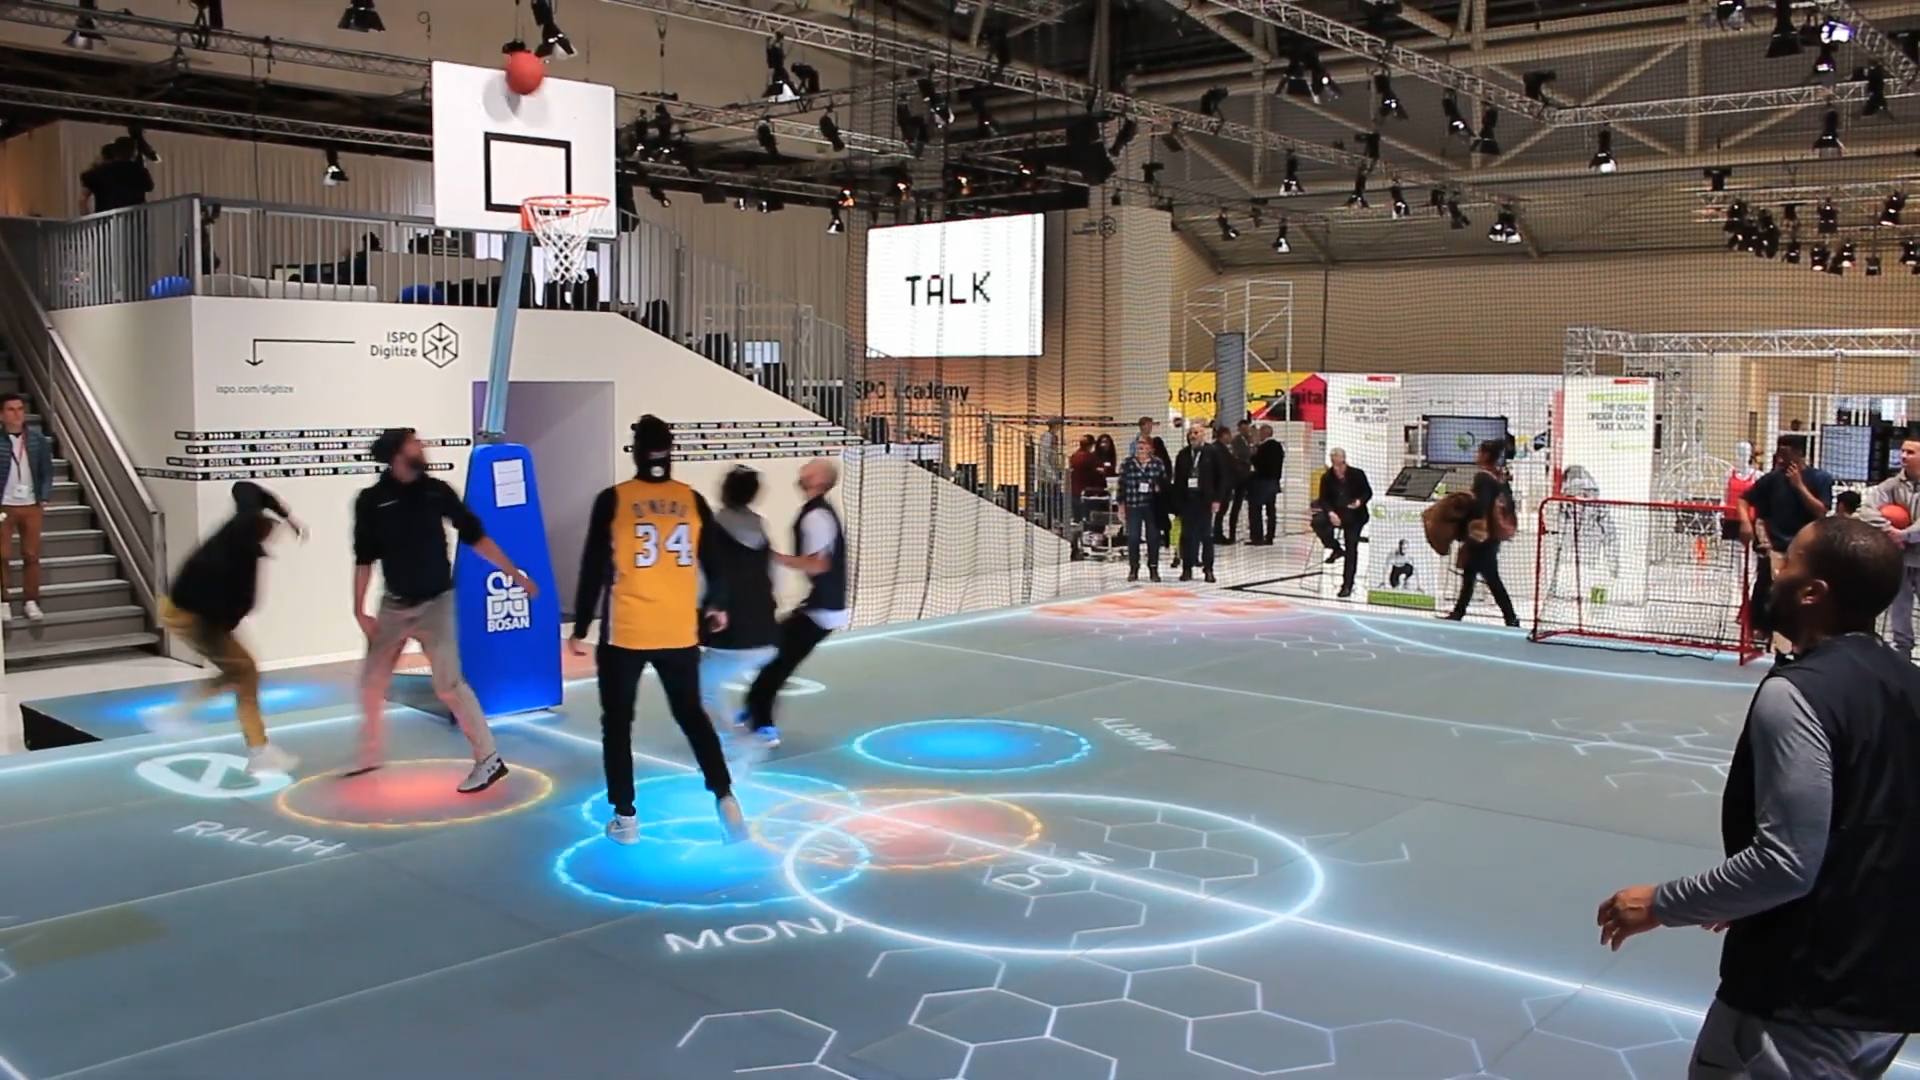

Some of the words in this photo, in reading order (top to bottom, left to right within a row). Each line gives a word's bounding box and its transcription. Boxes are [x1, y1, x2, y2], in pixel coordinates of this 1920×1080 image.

[904, 271, 991, 306] TALK
[386, 331, 418, 344] ISPO
[370, 345, 418, 359] Digitize
[215, 384, 295, 395] ispo.com/digitize
[852, 381, 887, 400] SPO
[240, 431, 261, 439] ISPO
[208, 458, 245, 467] DIGITAL
[634, 522, 693, 568] 34
[486, 617, 530, 632] BOSAN
[173, 820, 347, 856] RALPH
[663, 912, 863, 952] MONA
